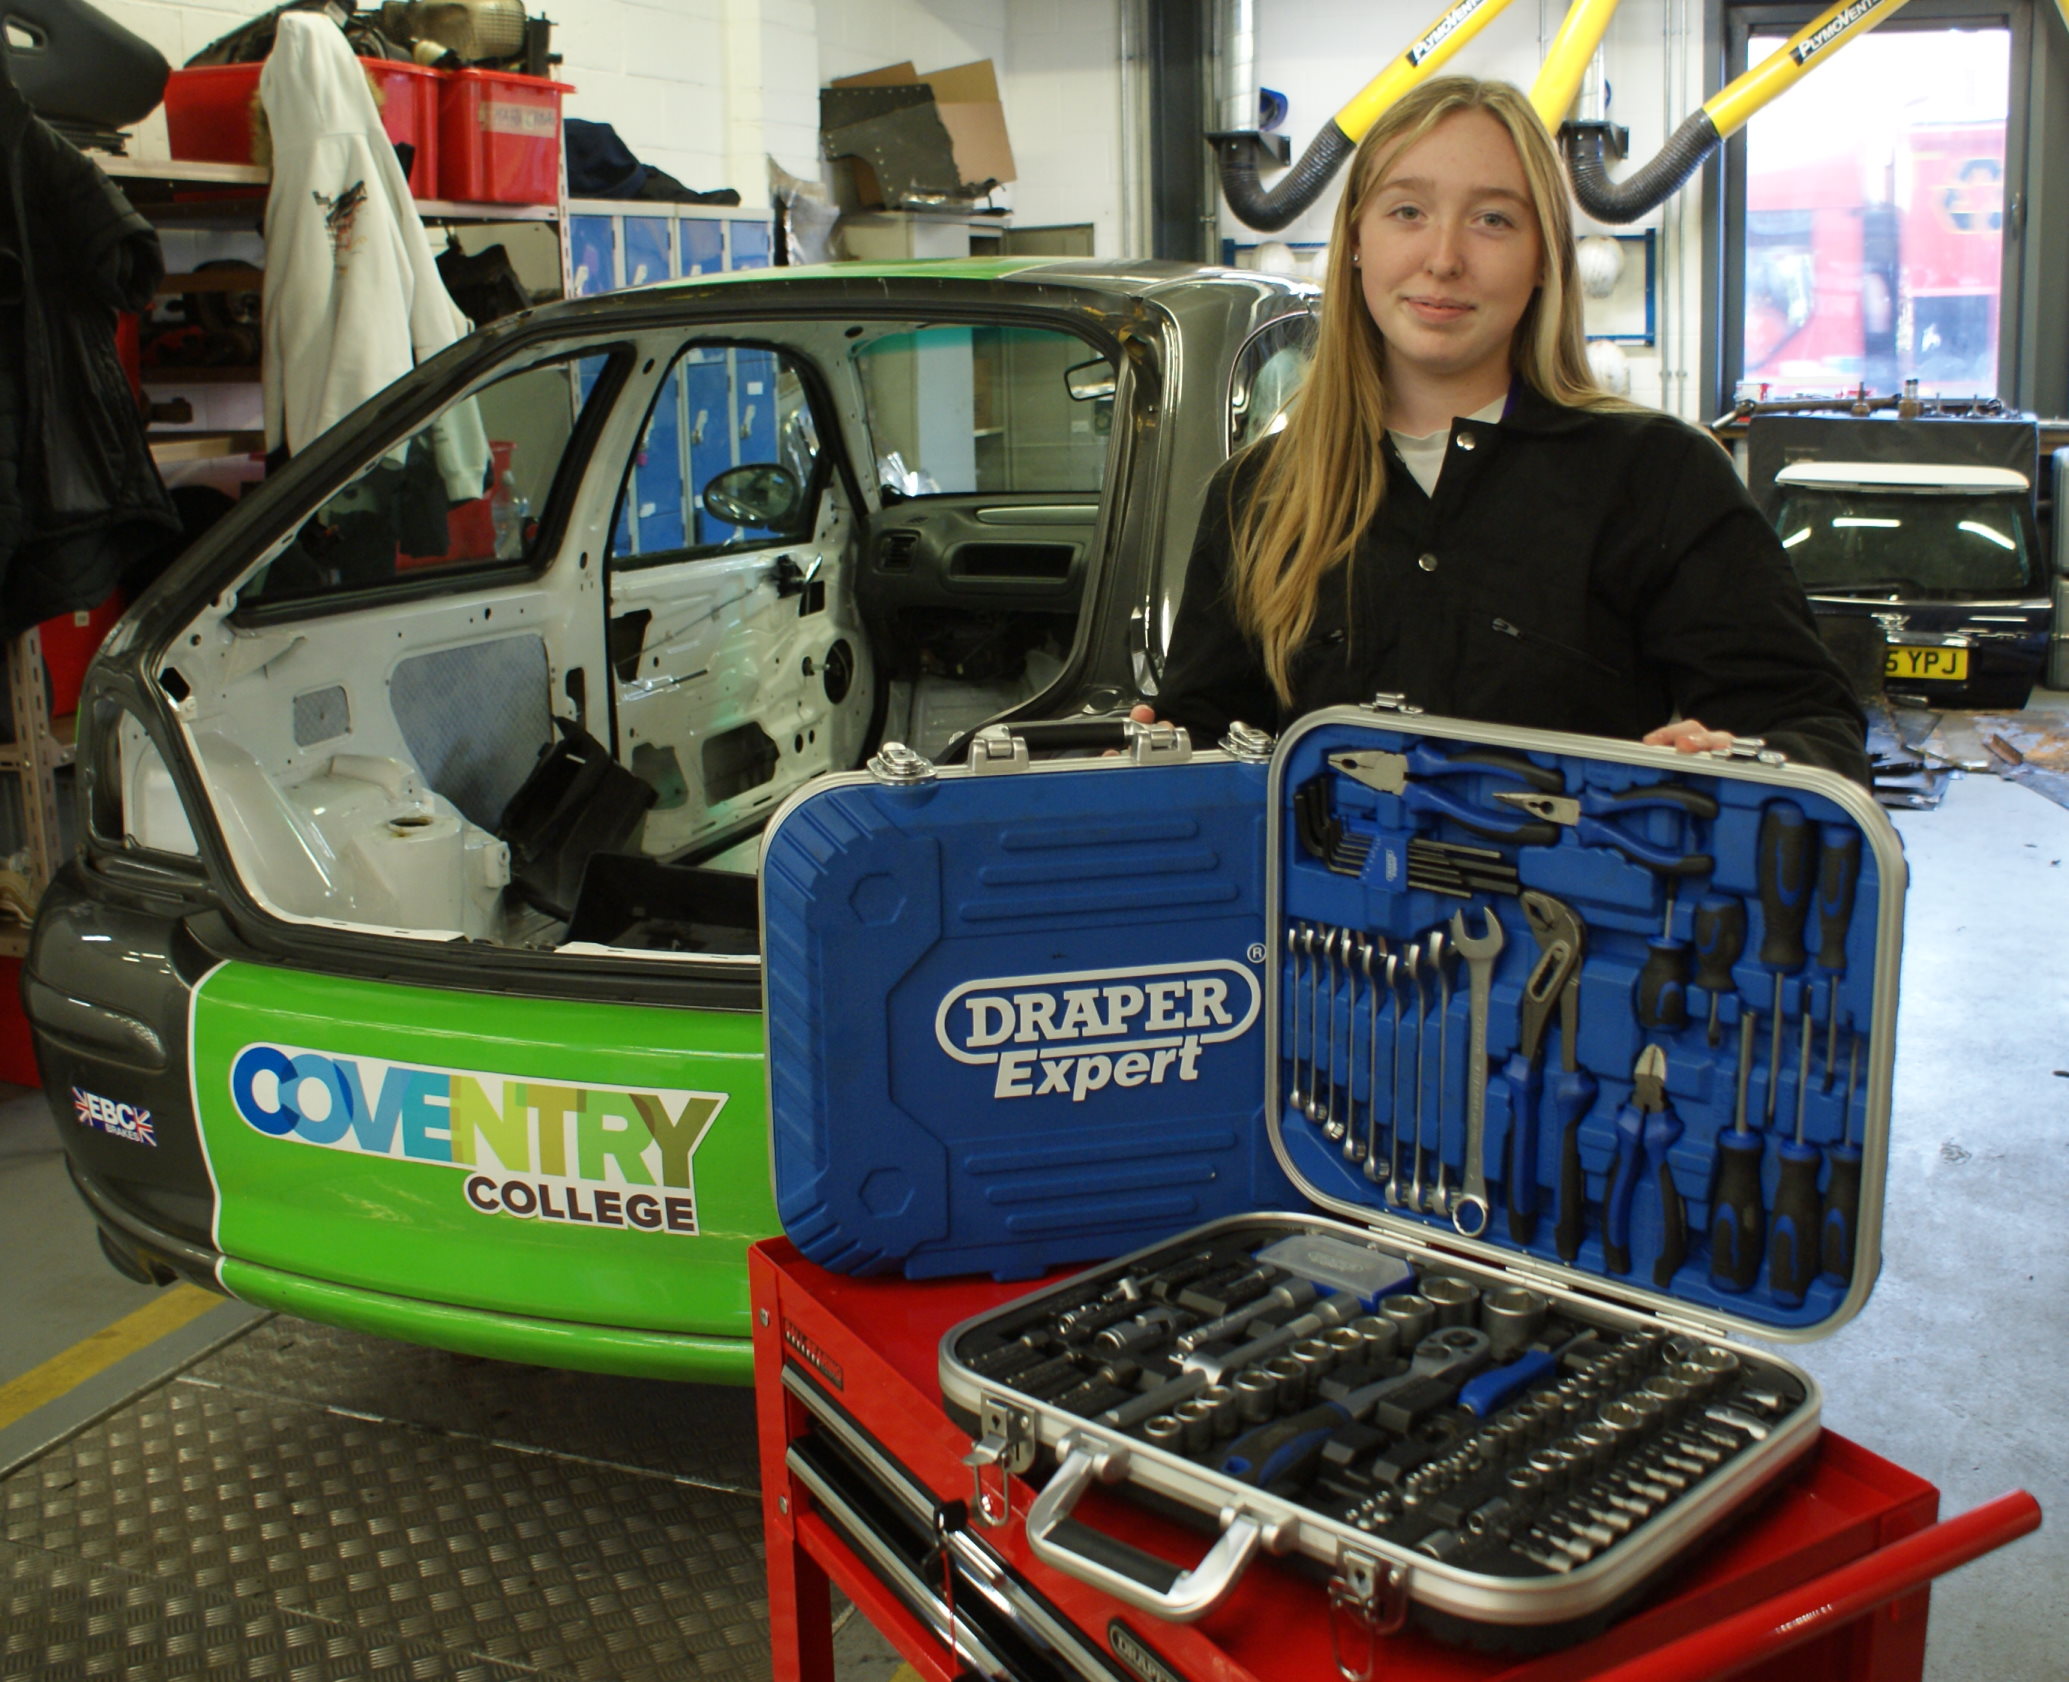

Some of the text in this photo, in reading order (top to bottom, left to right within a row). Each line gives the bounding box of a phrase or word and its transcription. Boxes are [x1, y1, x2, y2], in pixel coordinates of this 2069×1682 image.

[1907, 650, 1957, 675] YPJ
[965, 977, 1233, 1048] DRAPER
[993, 1034, 1203, 1102] Expert
[86, 1092, 137, 1131] EBC
[104, 1122, 141, 1142] BRAKES
[232, 1046, 721, 1189] COVENTRY
[467, 1175, 696, 1232] COLLEGE
